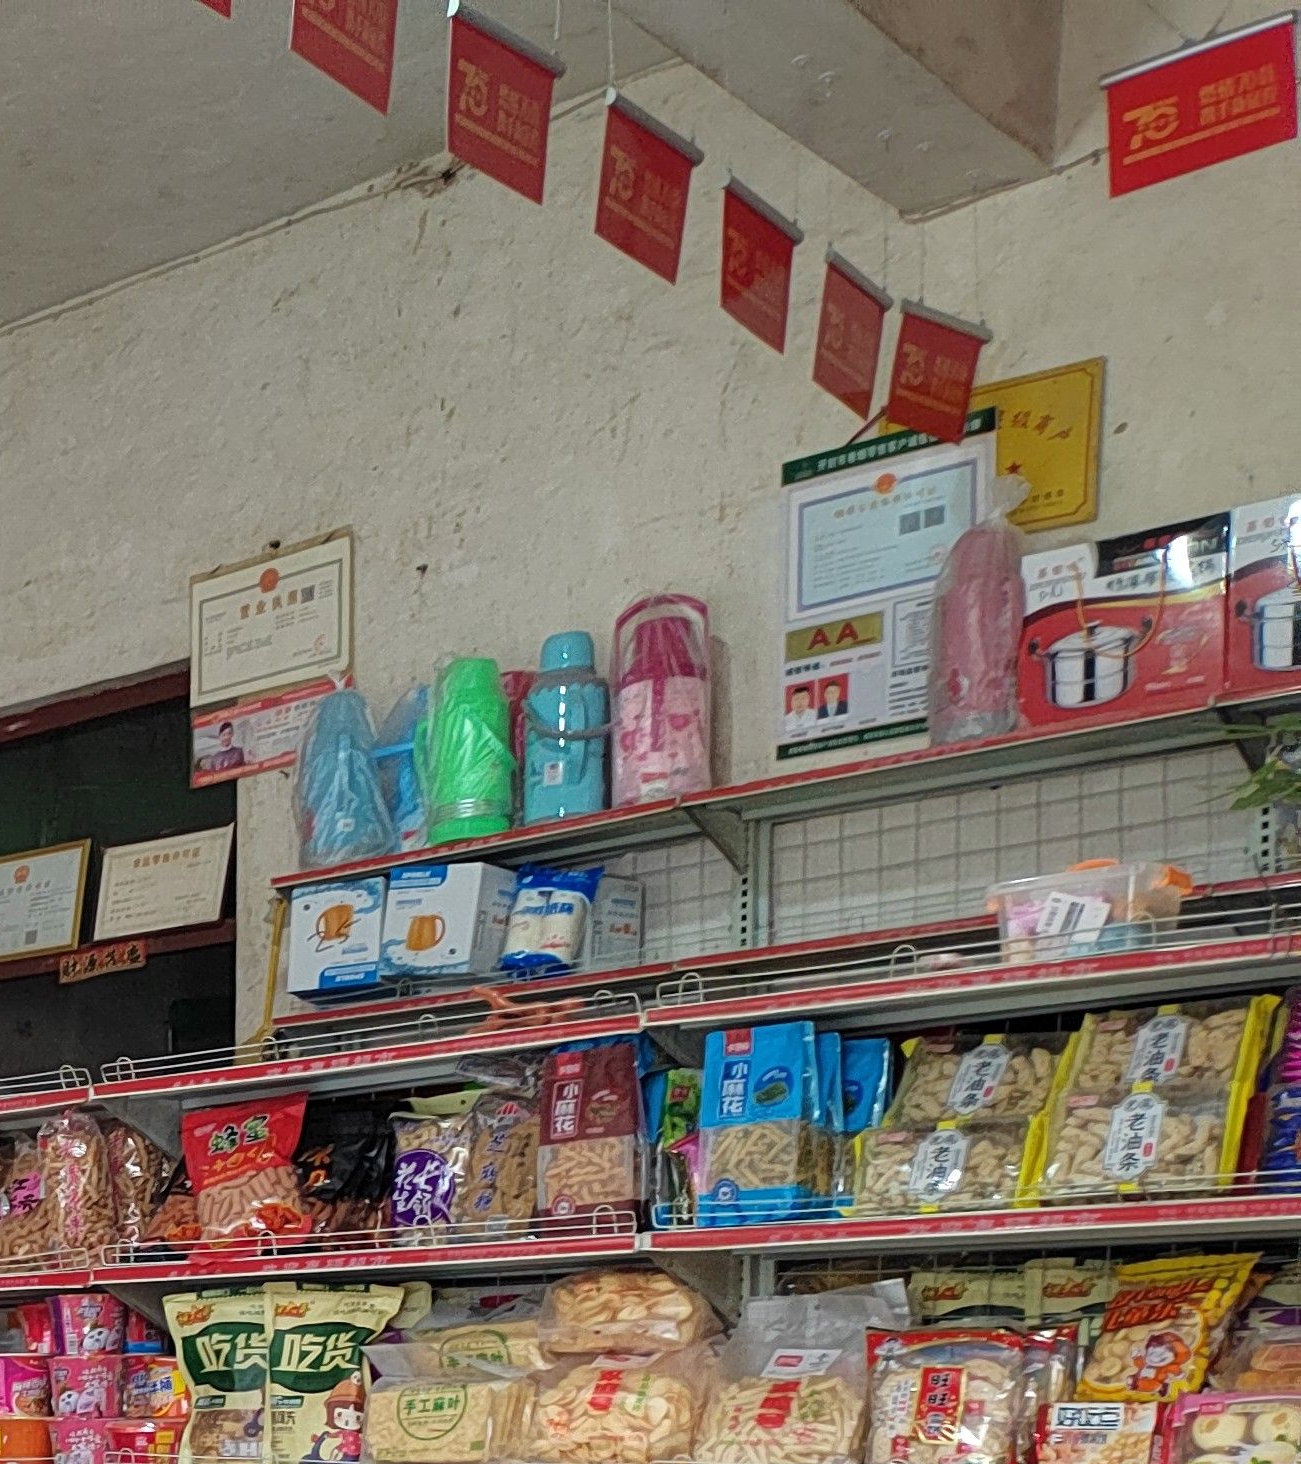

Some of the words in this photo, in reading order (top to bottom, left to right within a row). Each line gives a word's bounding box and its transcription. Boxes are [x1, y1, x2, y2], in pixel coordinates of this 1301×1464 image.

[808, 621, 860, 650] AA
[1141, 1031, 1169, 1082] 老油条
[720, 1060, 749, 1117] 小麻花
[960, 1060, 993, 1108] 老油条
[552, 1080, 581, 1138] 小麻花
[1119, 1112, 1149, 1172] 老油条
[198, 1331, 268, 1375] 吃货
[280, 1328, 360, 1373] 吃货
